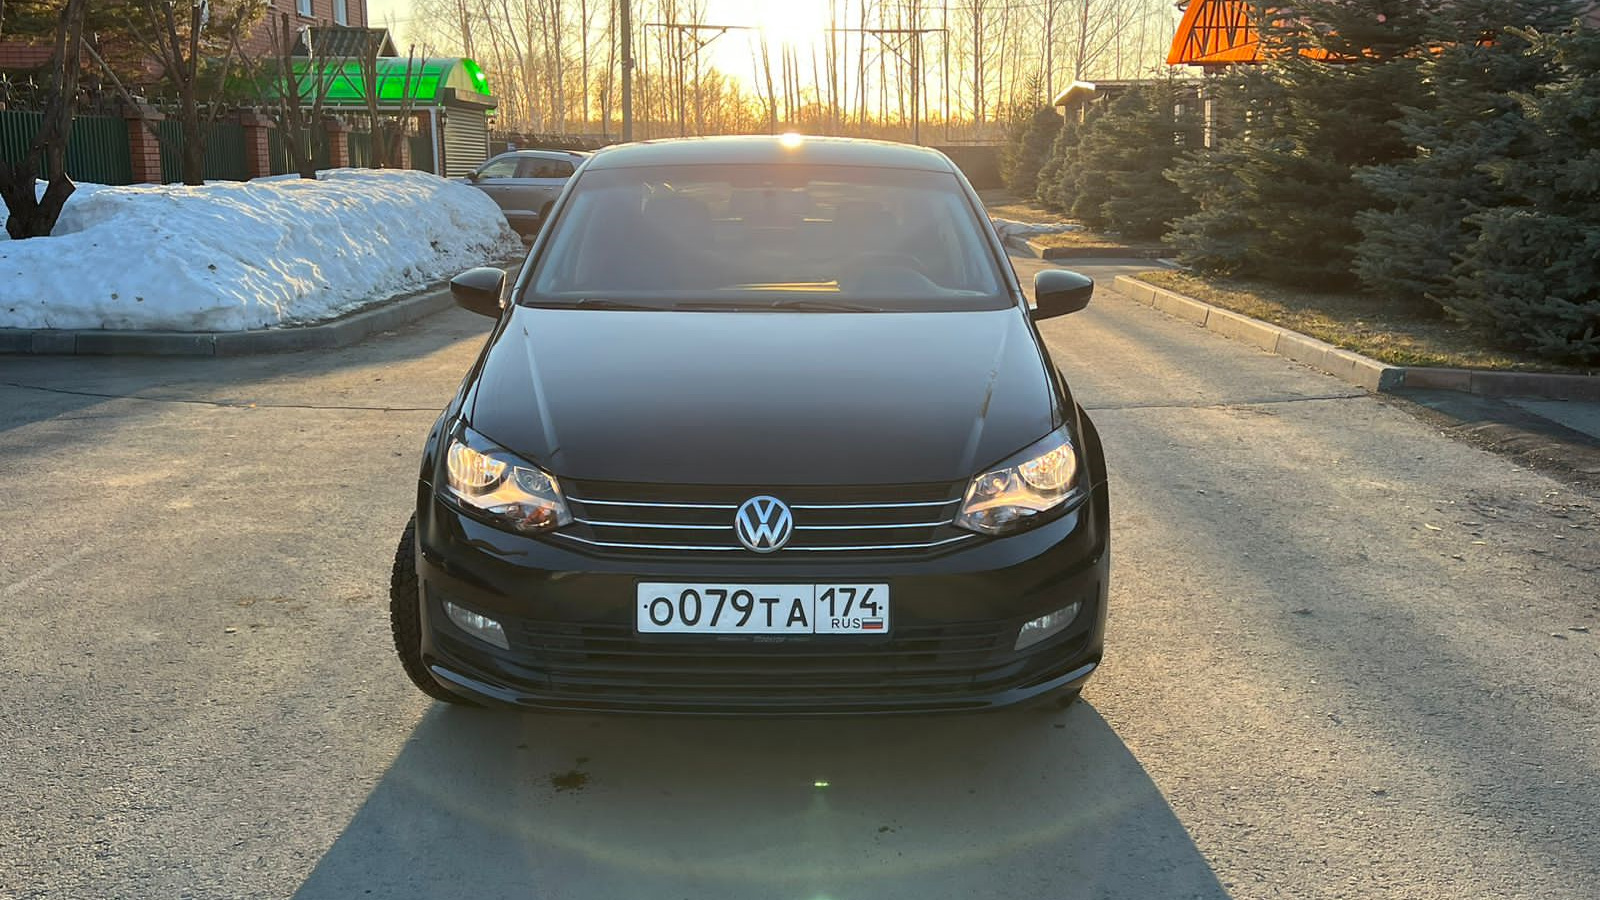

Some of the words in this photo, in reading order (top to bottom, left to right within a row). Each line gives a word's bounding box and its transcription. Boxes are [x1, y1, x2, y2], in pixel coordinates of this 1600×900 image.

[736, 495, 792, 553] VW
[820, 588, 877, 618] 174
[831, 618, 861, 629] RUS
